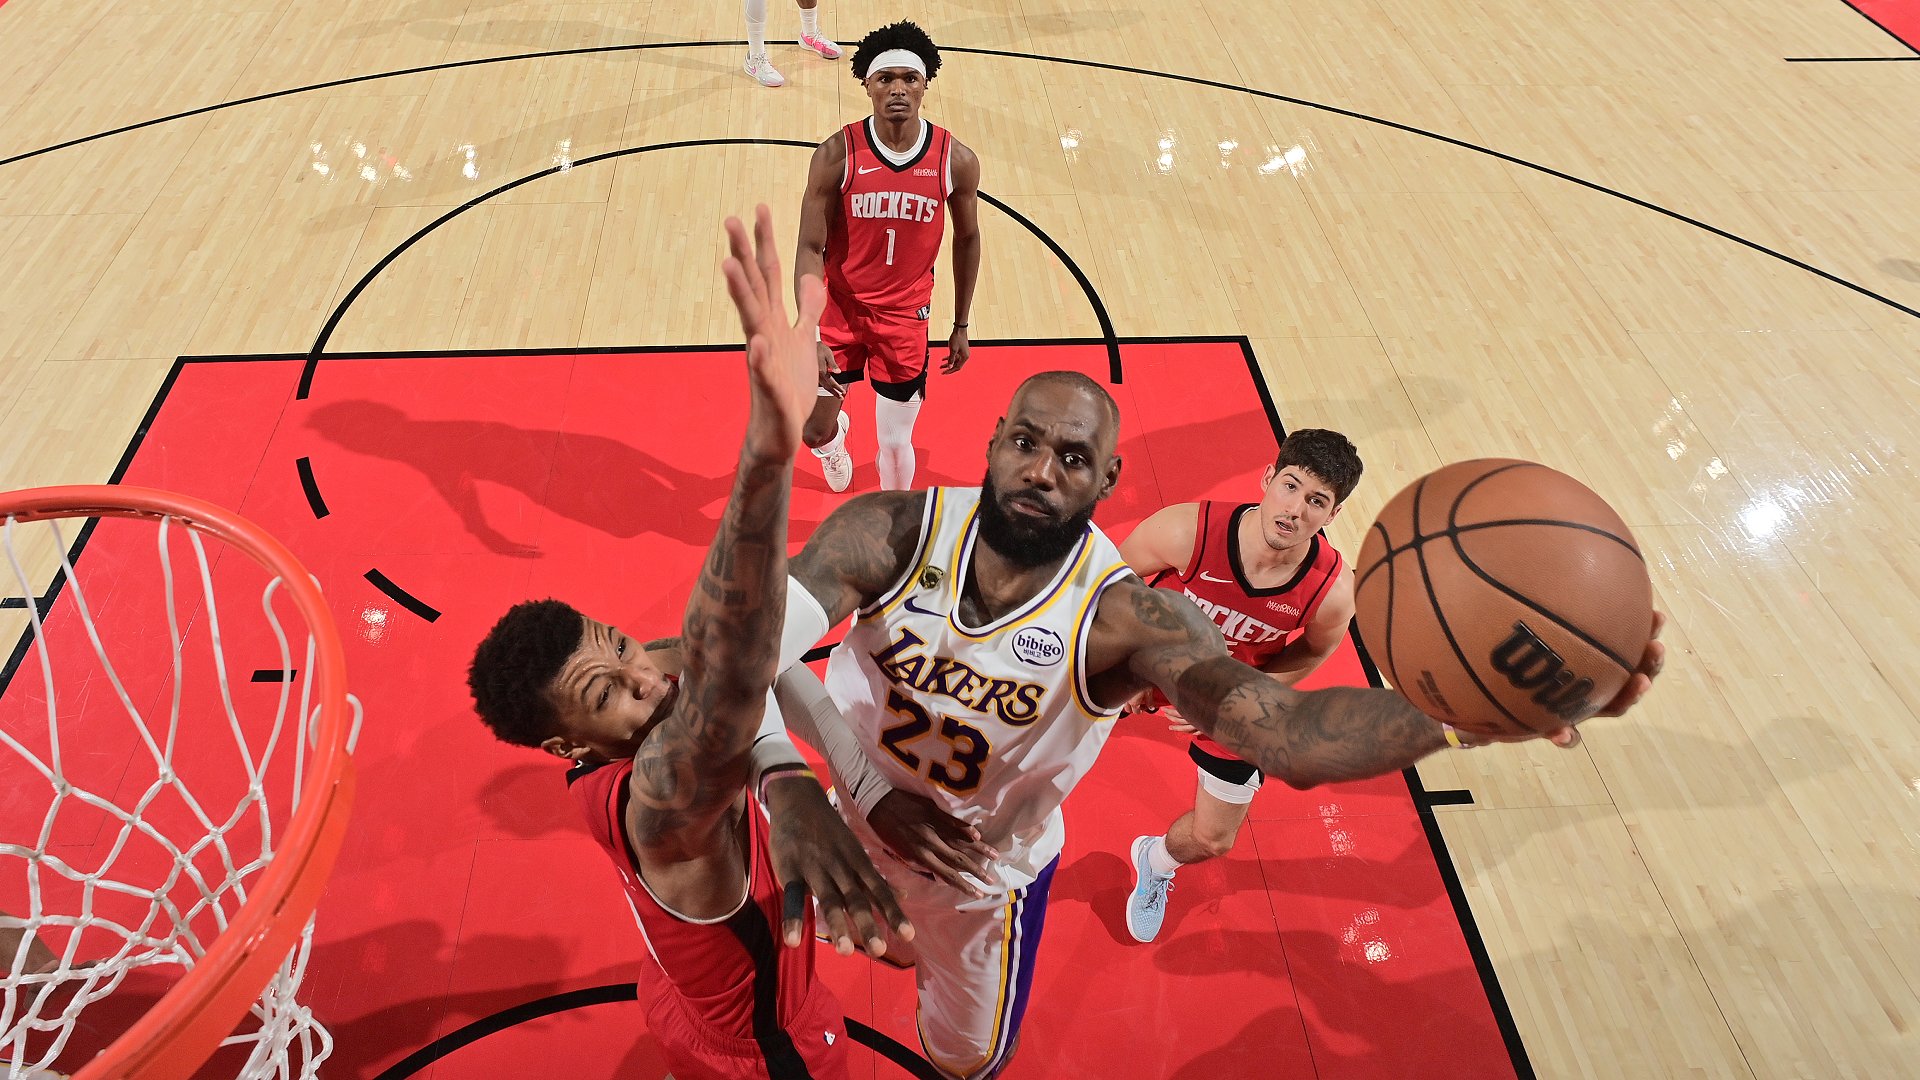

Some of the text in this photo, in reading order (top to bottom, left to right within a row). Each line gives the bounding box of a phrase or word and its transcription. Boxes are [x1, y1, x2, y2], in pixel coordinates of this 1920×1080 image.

[850, 191, 939, 223] ROCKETS
[885, 228, 896, 266] 1
[1017, 634, 1061, 657] bibigo
[1023, 648, 1042, 659] 비비고
[868, 624, 1048, 729] LAKERS
[878, 688, 993, 798] 23
